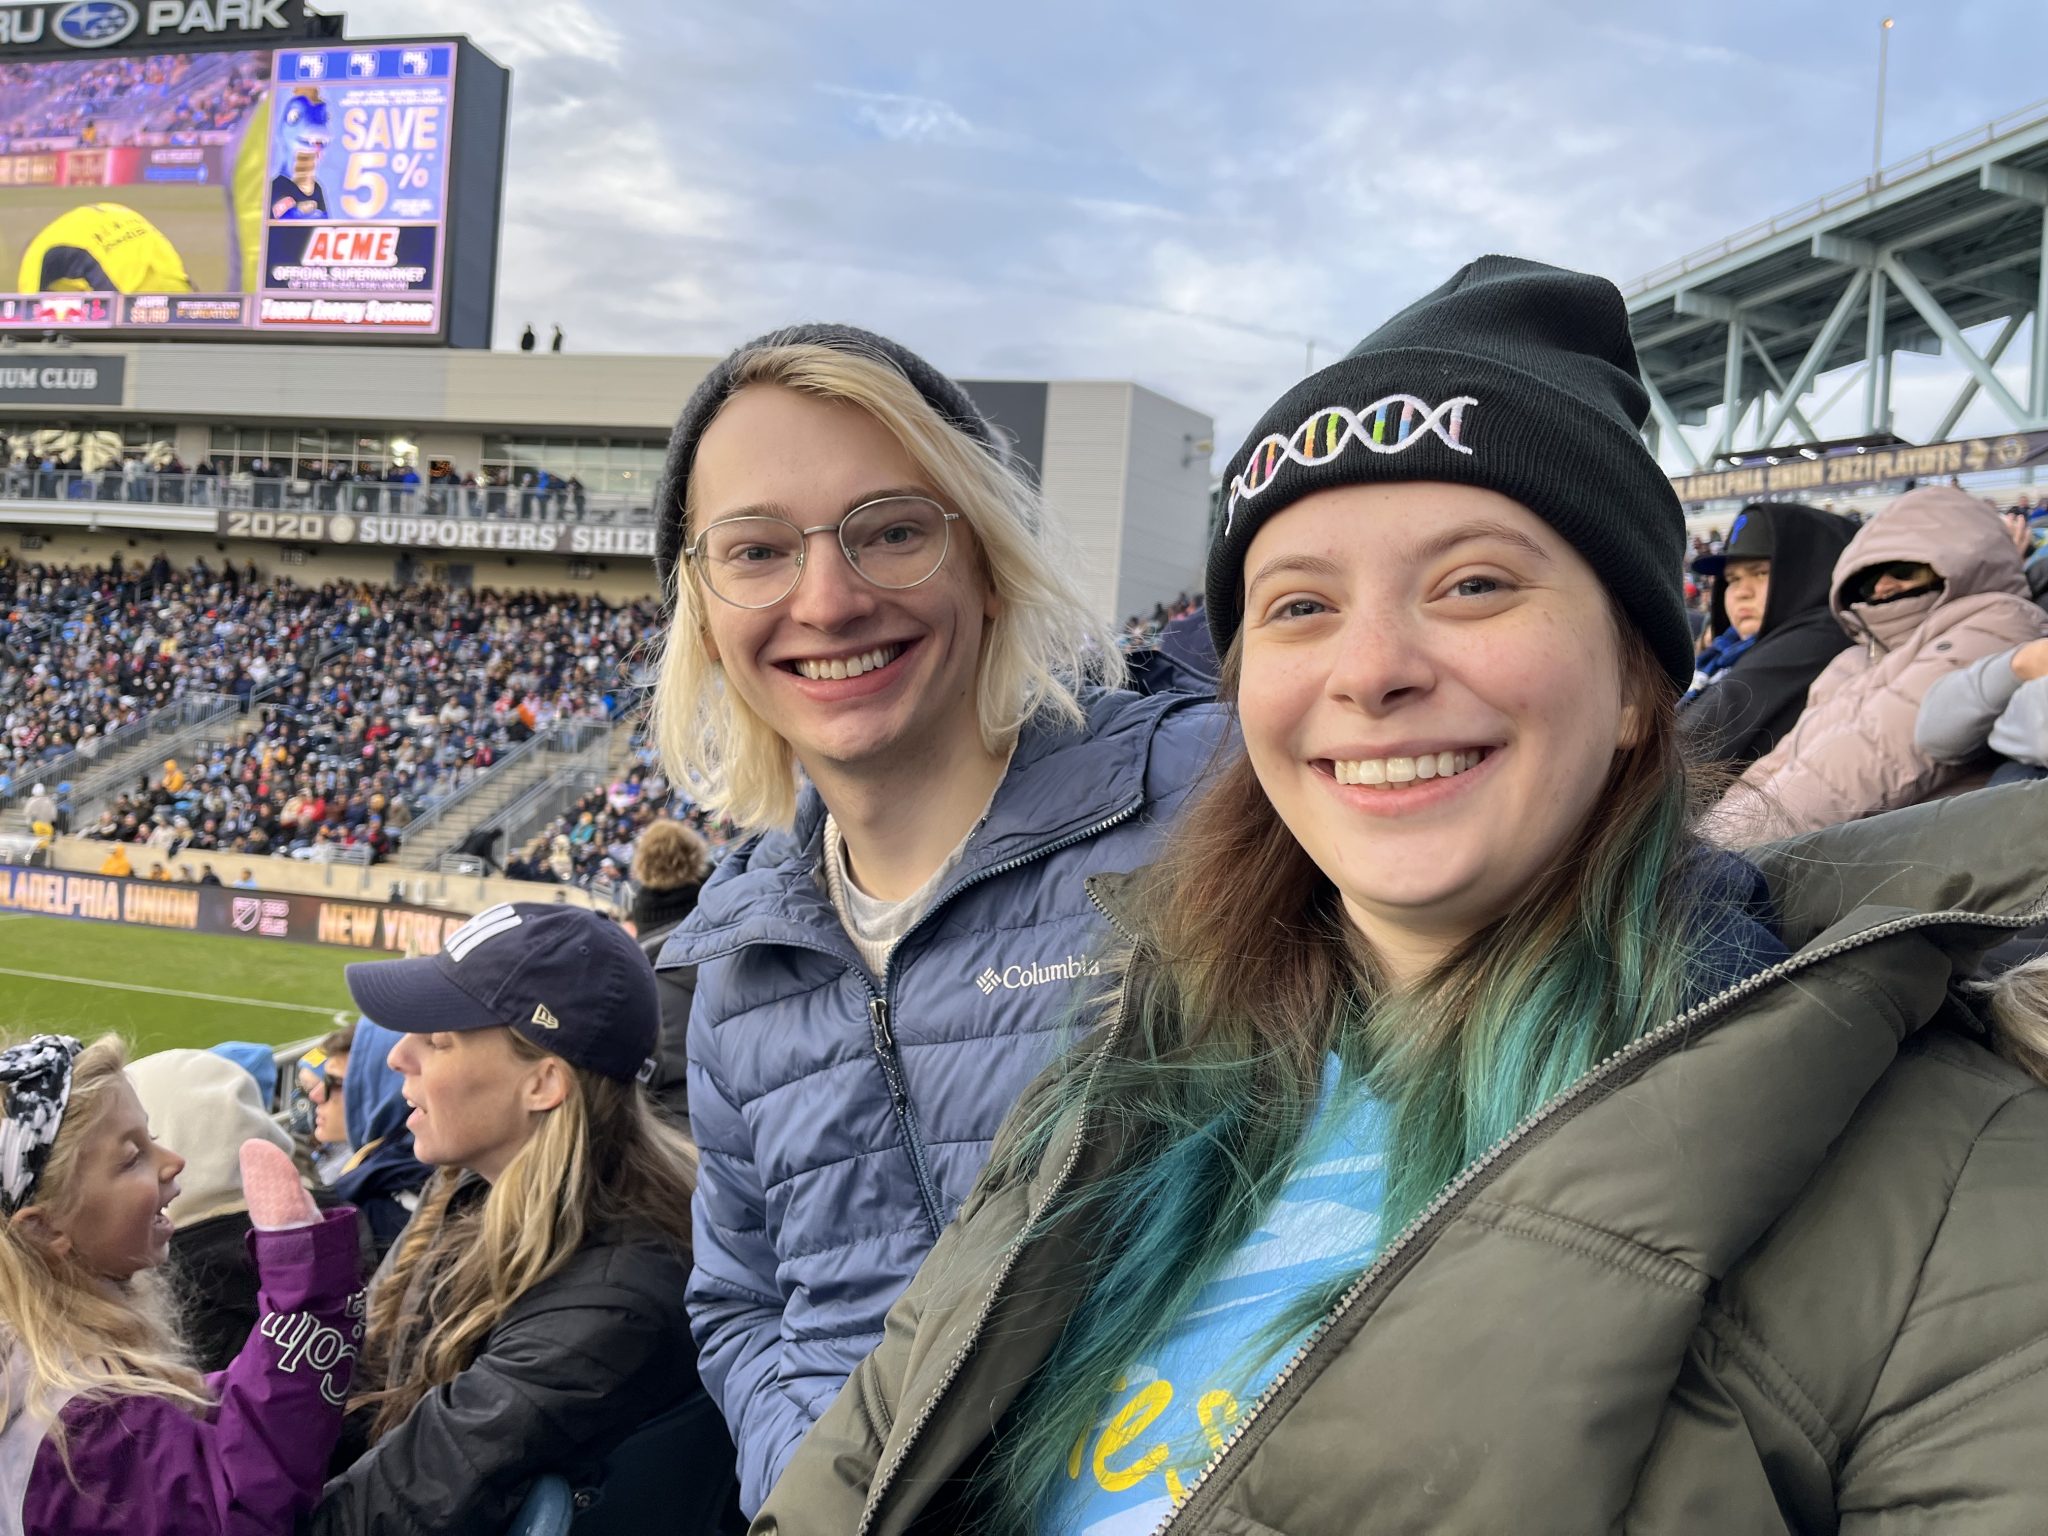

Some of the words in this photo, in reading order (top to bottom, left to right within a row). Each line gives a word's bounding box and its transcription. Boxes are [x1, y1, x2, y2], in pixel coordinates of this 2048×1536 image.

[147, 0, 289, 35] PARK
[342, 106, 439, 151] SAVE
[306, 231, 396, 263] ACME
[273, 266, 328, 281] OFFICIAL
[329, 267, 426, 282] SUPERMARKET
[40, 367, 98, 390] CLUB
[1827, 452, 1872, 485] 2021
[228, 511, 324, 542] 2020
[359, 516, 566, 552] SUPPORTERS'
[124, 882, 199, 929] UNION
[318, 902, 378, 948] NEW
[382, 908, 442, 956] YORK
